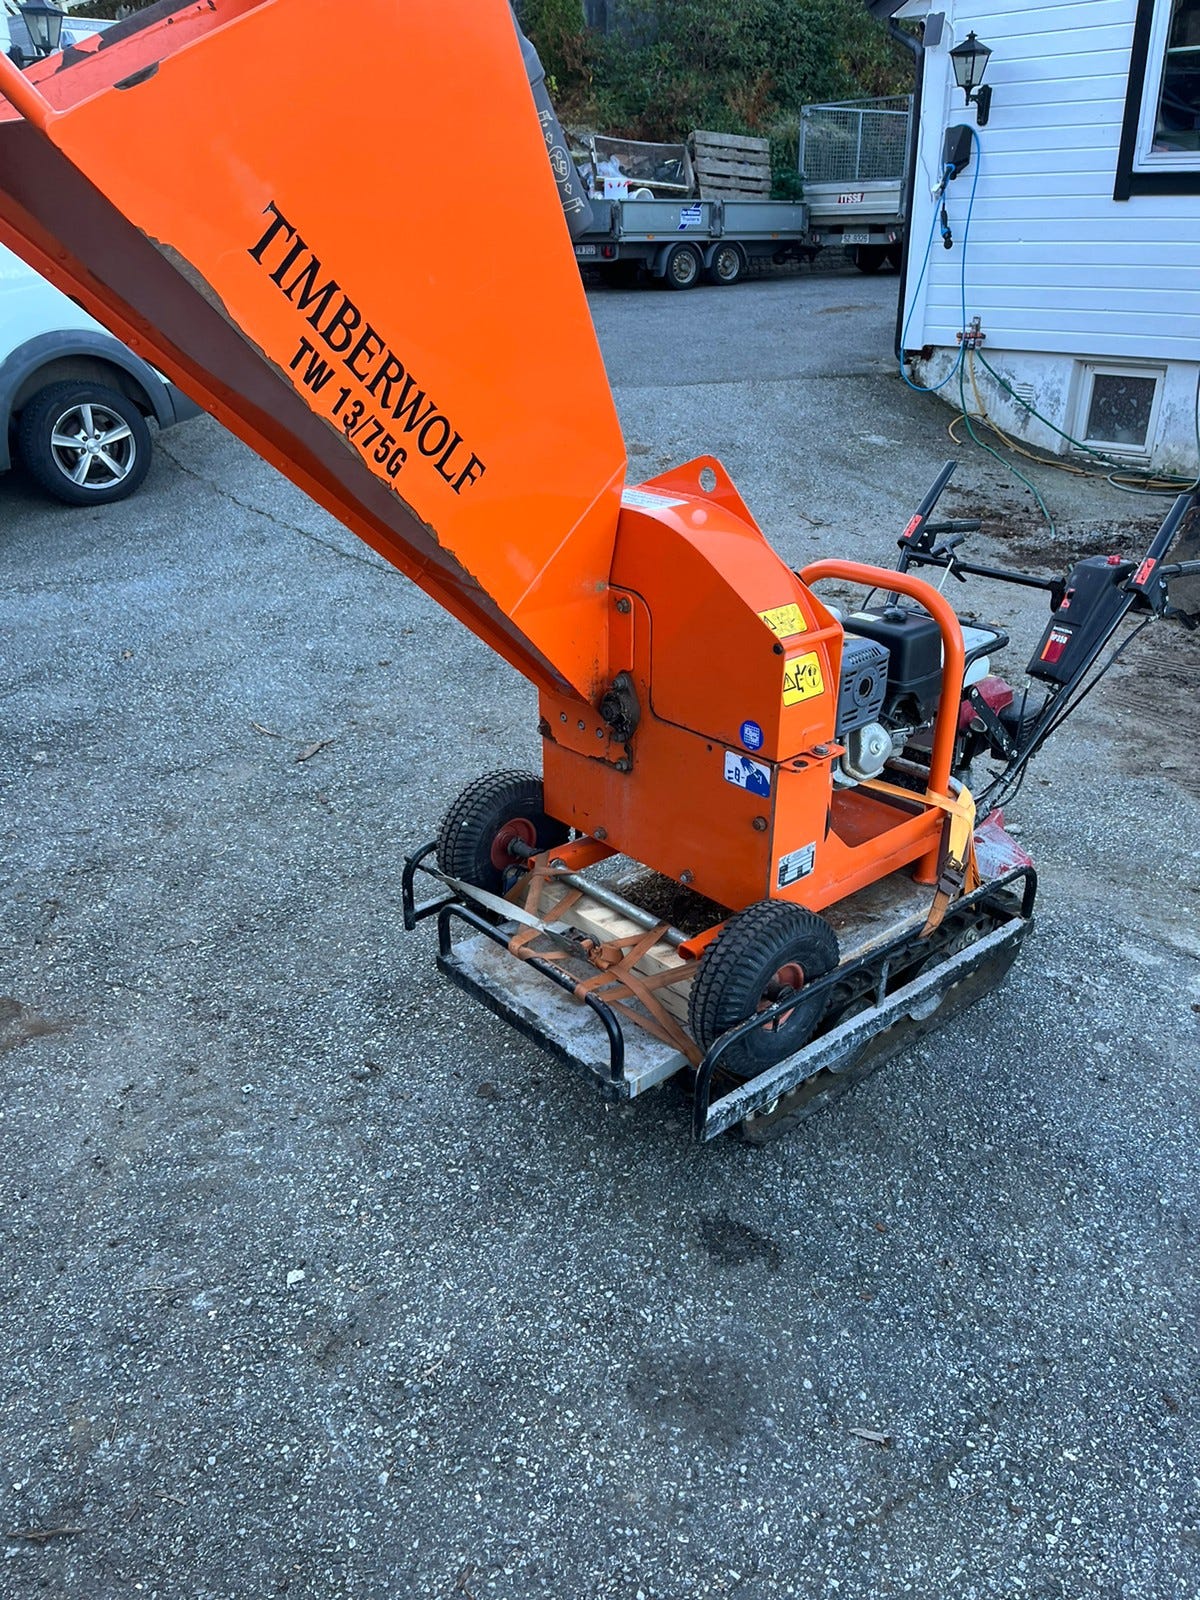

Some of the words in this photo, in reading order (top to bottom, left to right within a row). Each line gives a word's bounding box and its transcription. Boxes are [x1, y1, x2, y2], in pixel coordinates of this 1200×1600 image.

[247, 200, 487, 495] TIMBERWOLF
[289, 336, 336, 394] TW
[331, 387, 408, 479] 13/75G
